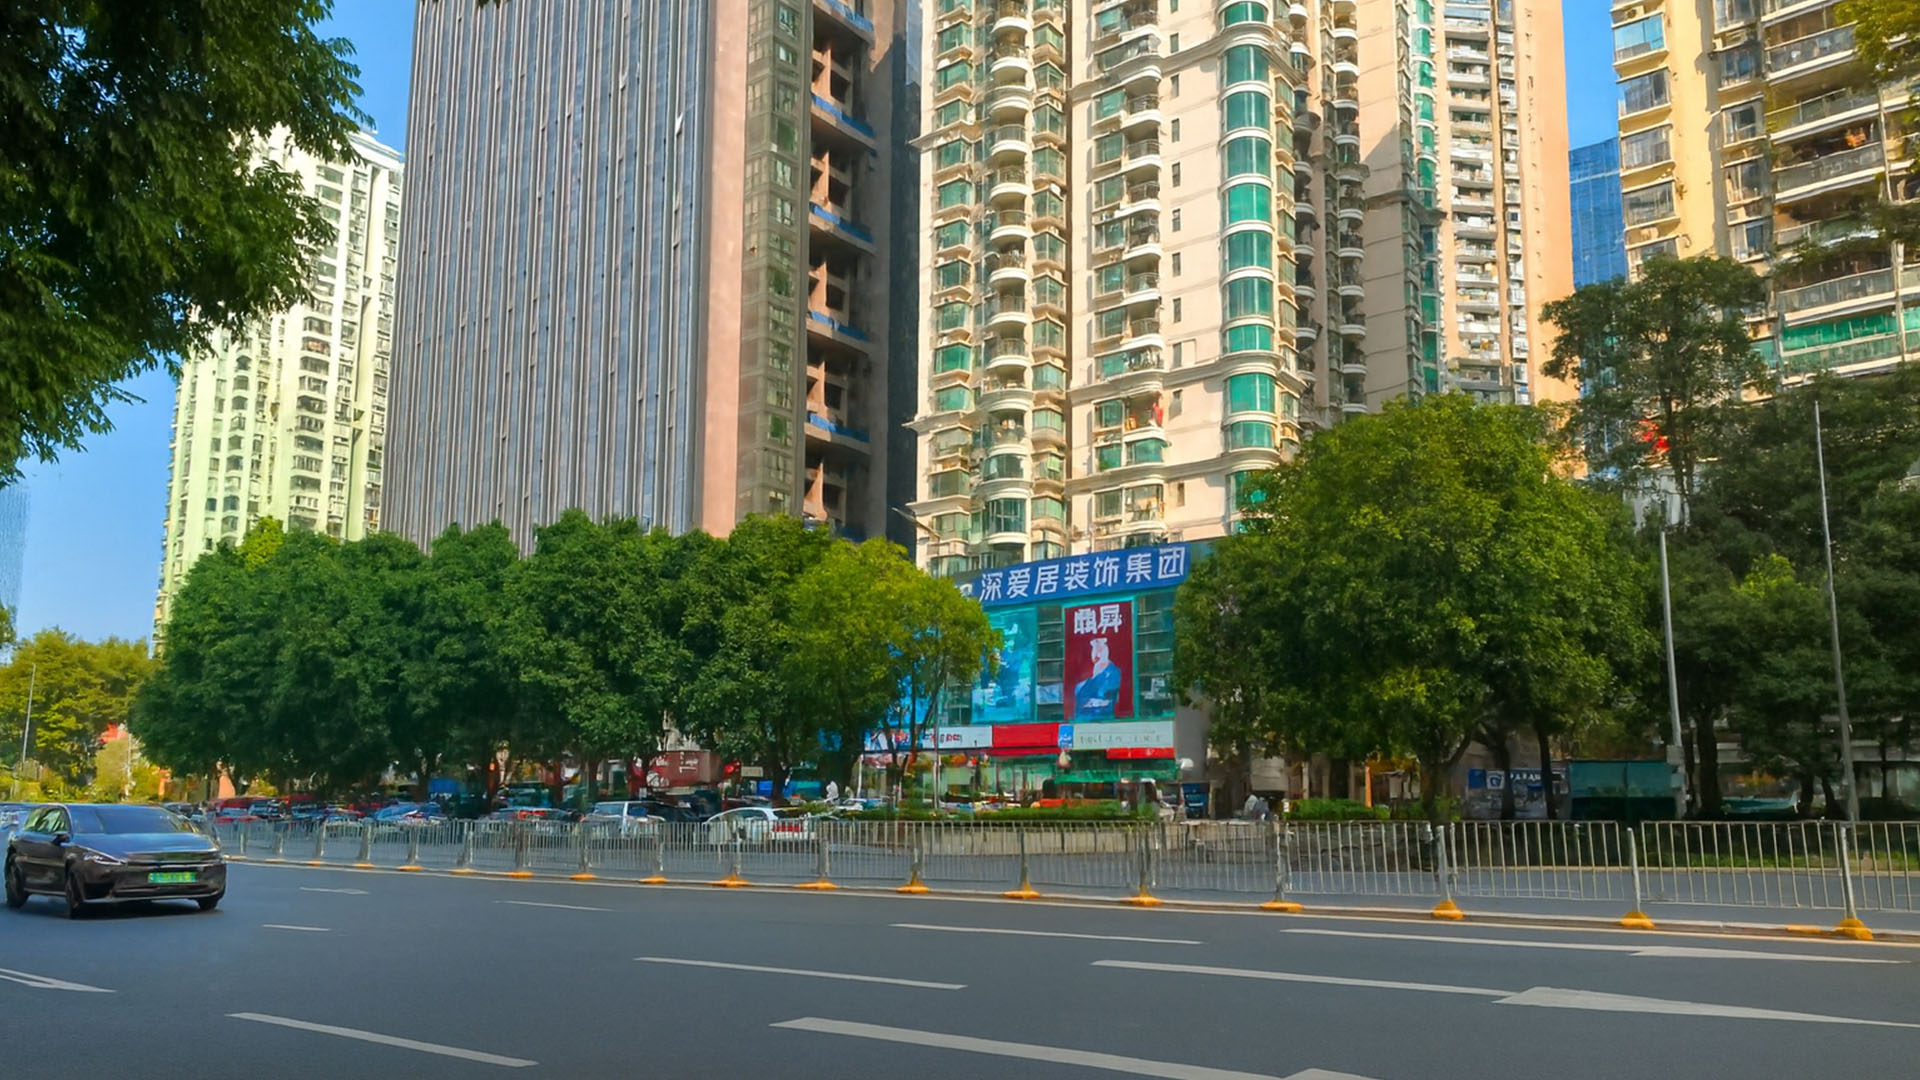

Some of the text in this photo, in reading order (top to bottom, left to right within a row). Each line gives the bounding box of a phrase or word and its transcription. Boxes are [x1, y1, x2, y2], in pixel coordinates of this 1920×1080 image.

[979, 546, 1186, 602] 深爱居装饰集团
